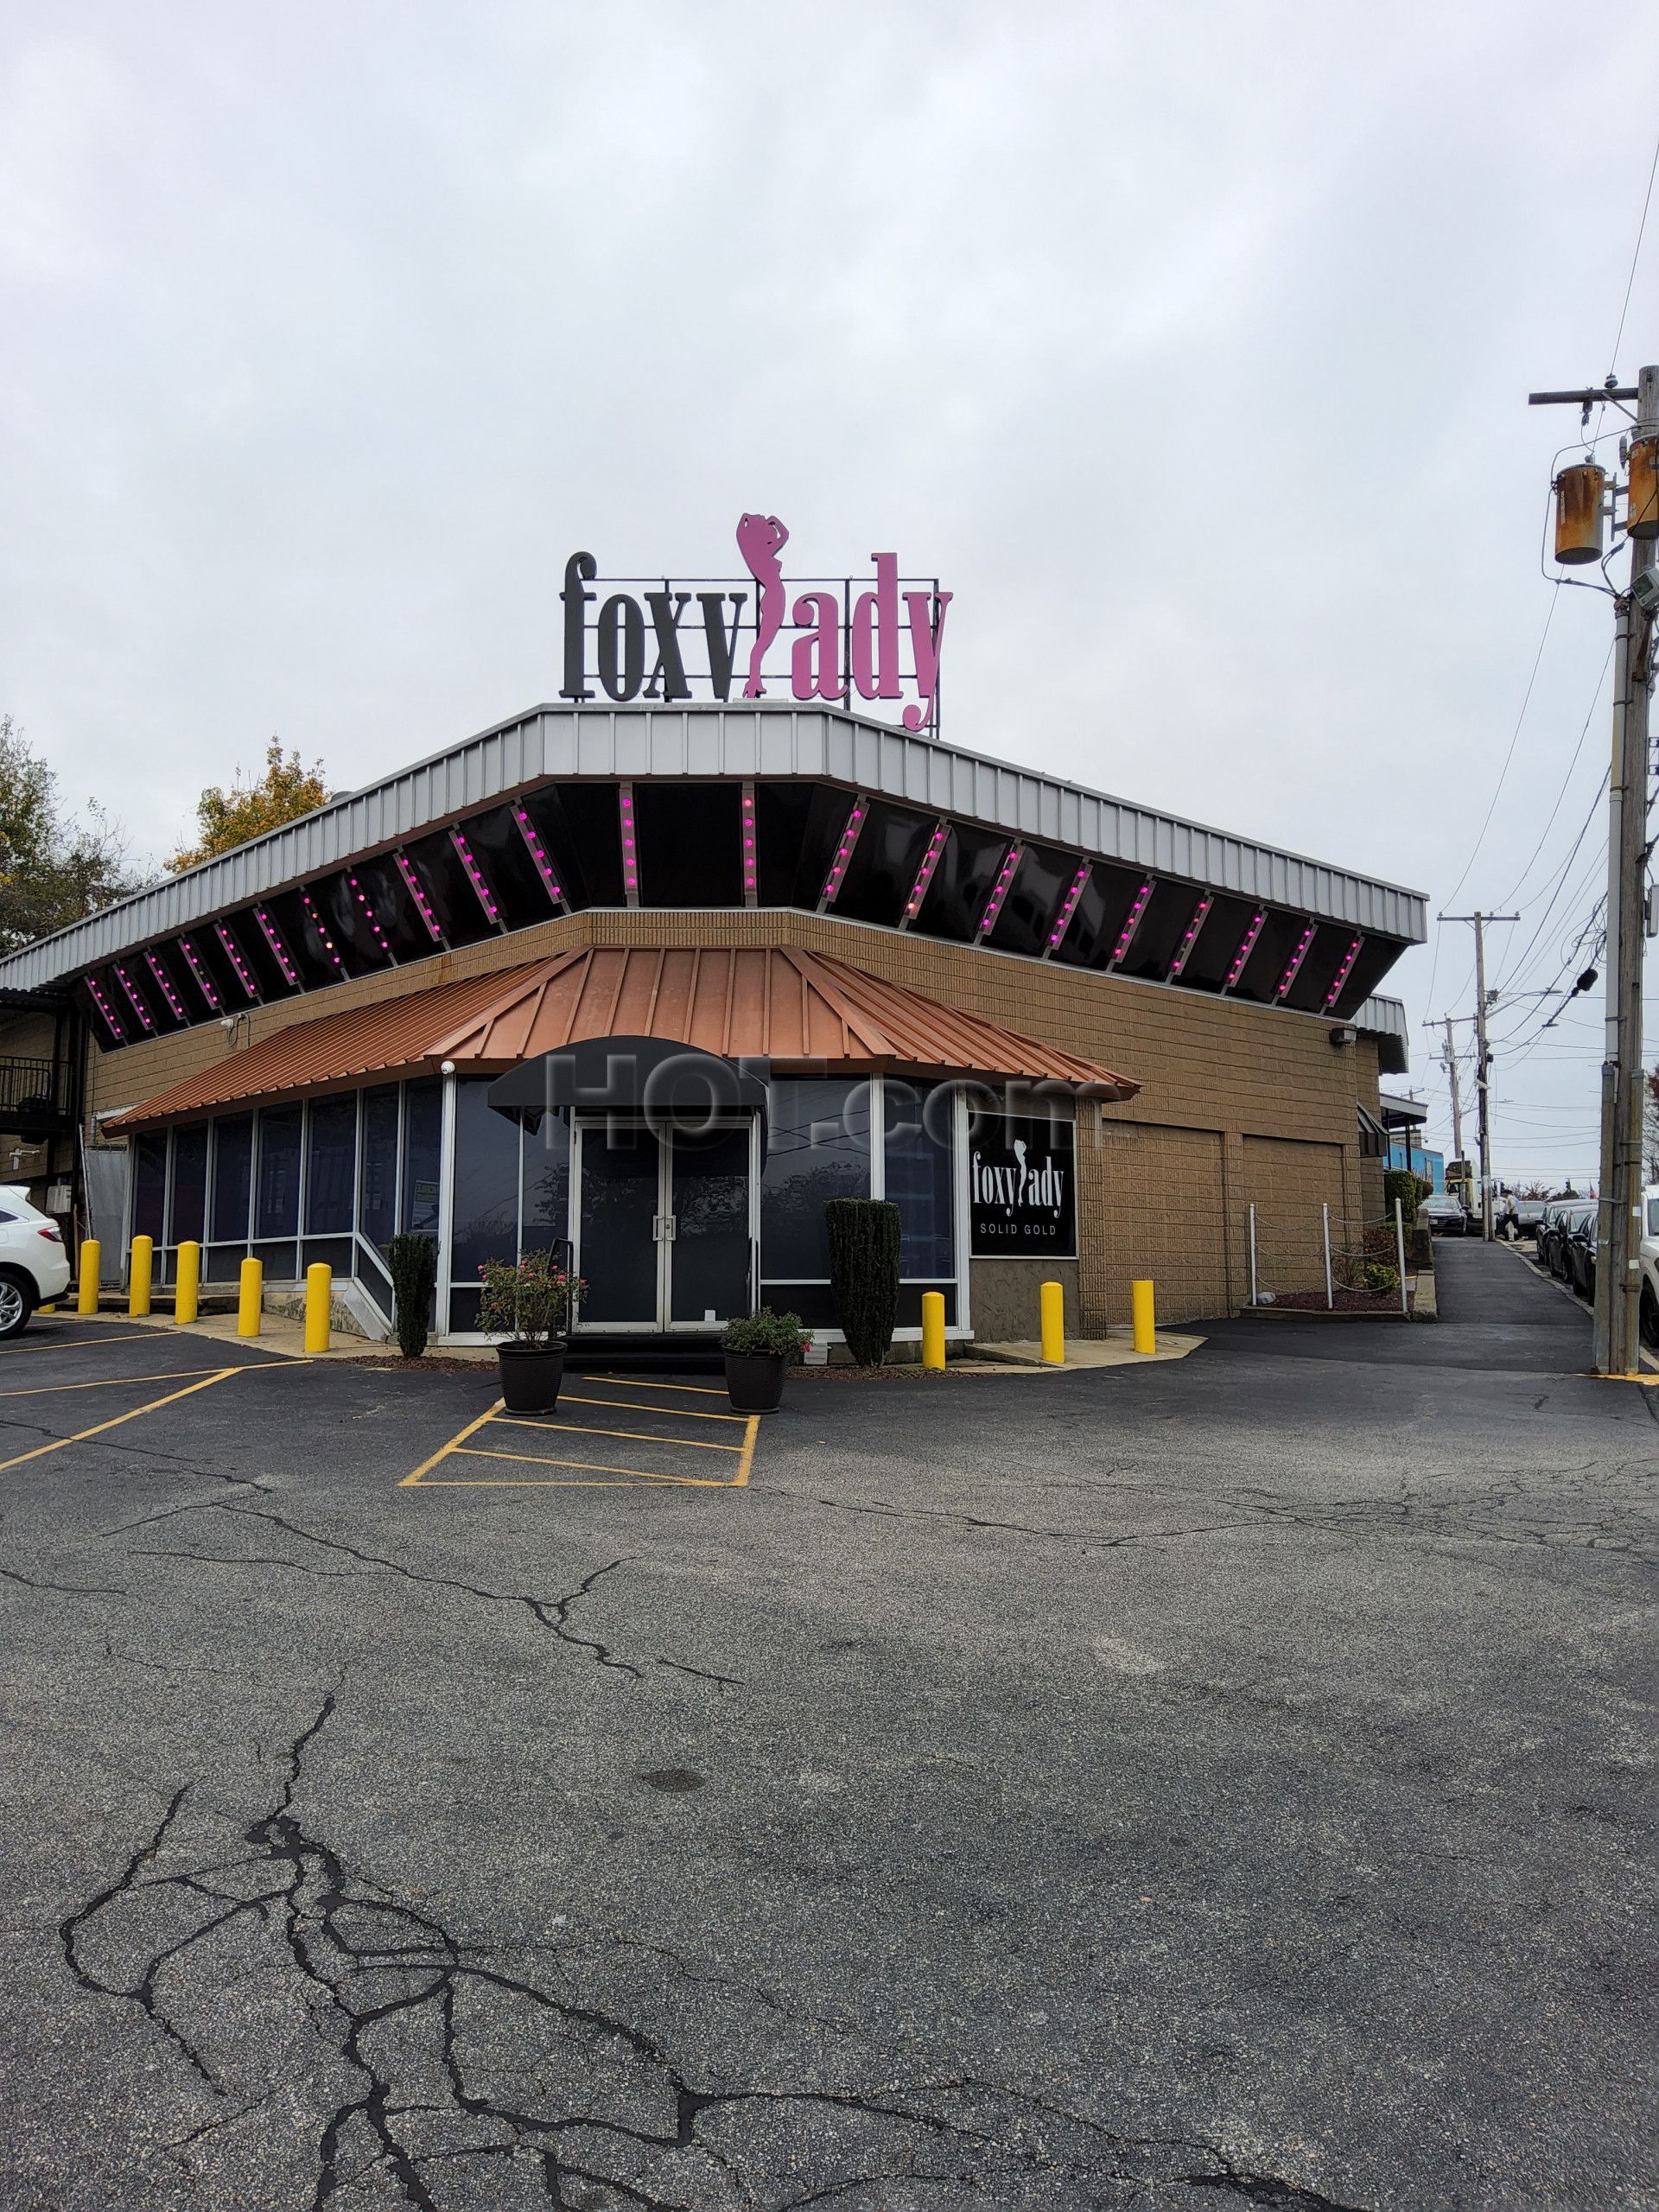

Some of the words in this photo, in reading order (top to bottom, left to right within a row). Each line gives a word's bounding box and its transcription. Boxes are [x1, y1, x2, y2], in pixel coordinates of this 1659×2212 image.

[972, 1151, 1017, 1217] foxy
[980, 1224, 1018, 1235] SOLID
[1024, 1224, 1057, 1236] GOLD
